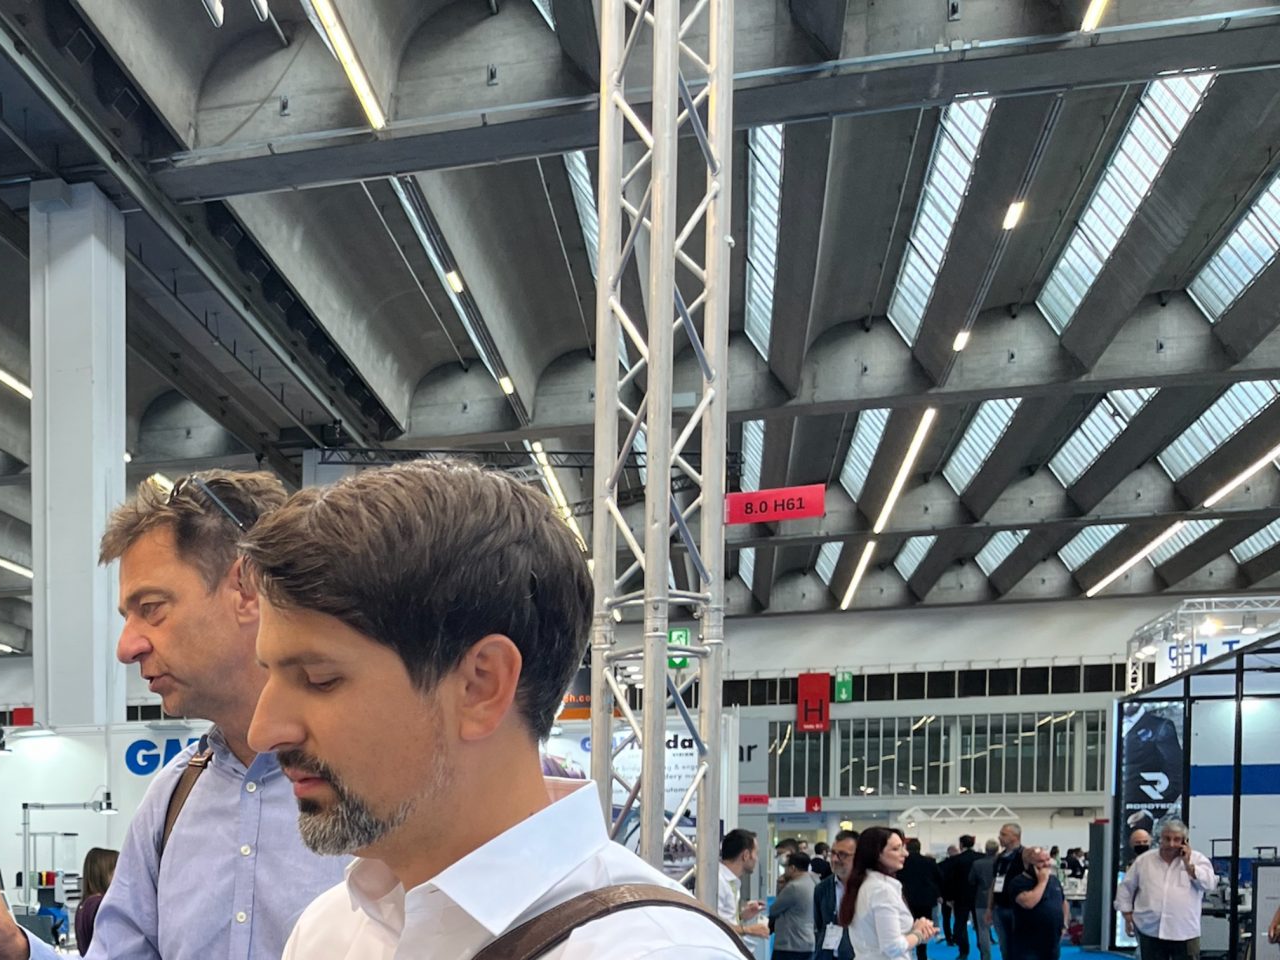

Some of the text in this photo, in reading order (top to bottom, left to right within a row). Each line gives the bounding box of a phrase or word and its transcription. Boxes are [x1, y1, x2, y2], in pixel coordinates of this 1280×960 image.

[744, 497, 805, 515] 8.0 H61
[804, 699, 824, 722] H
